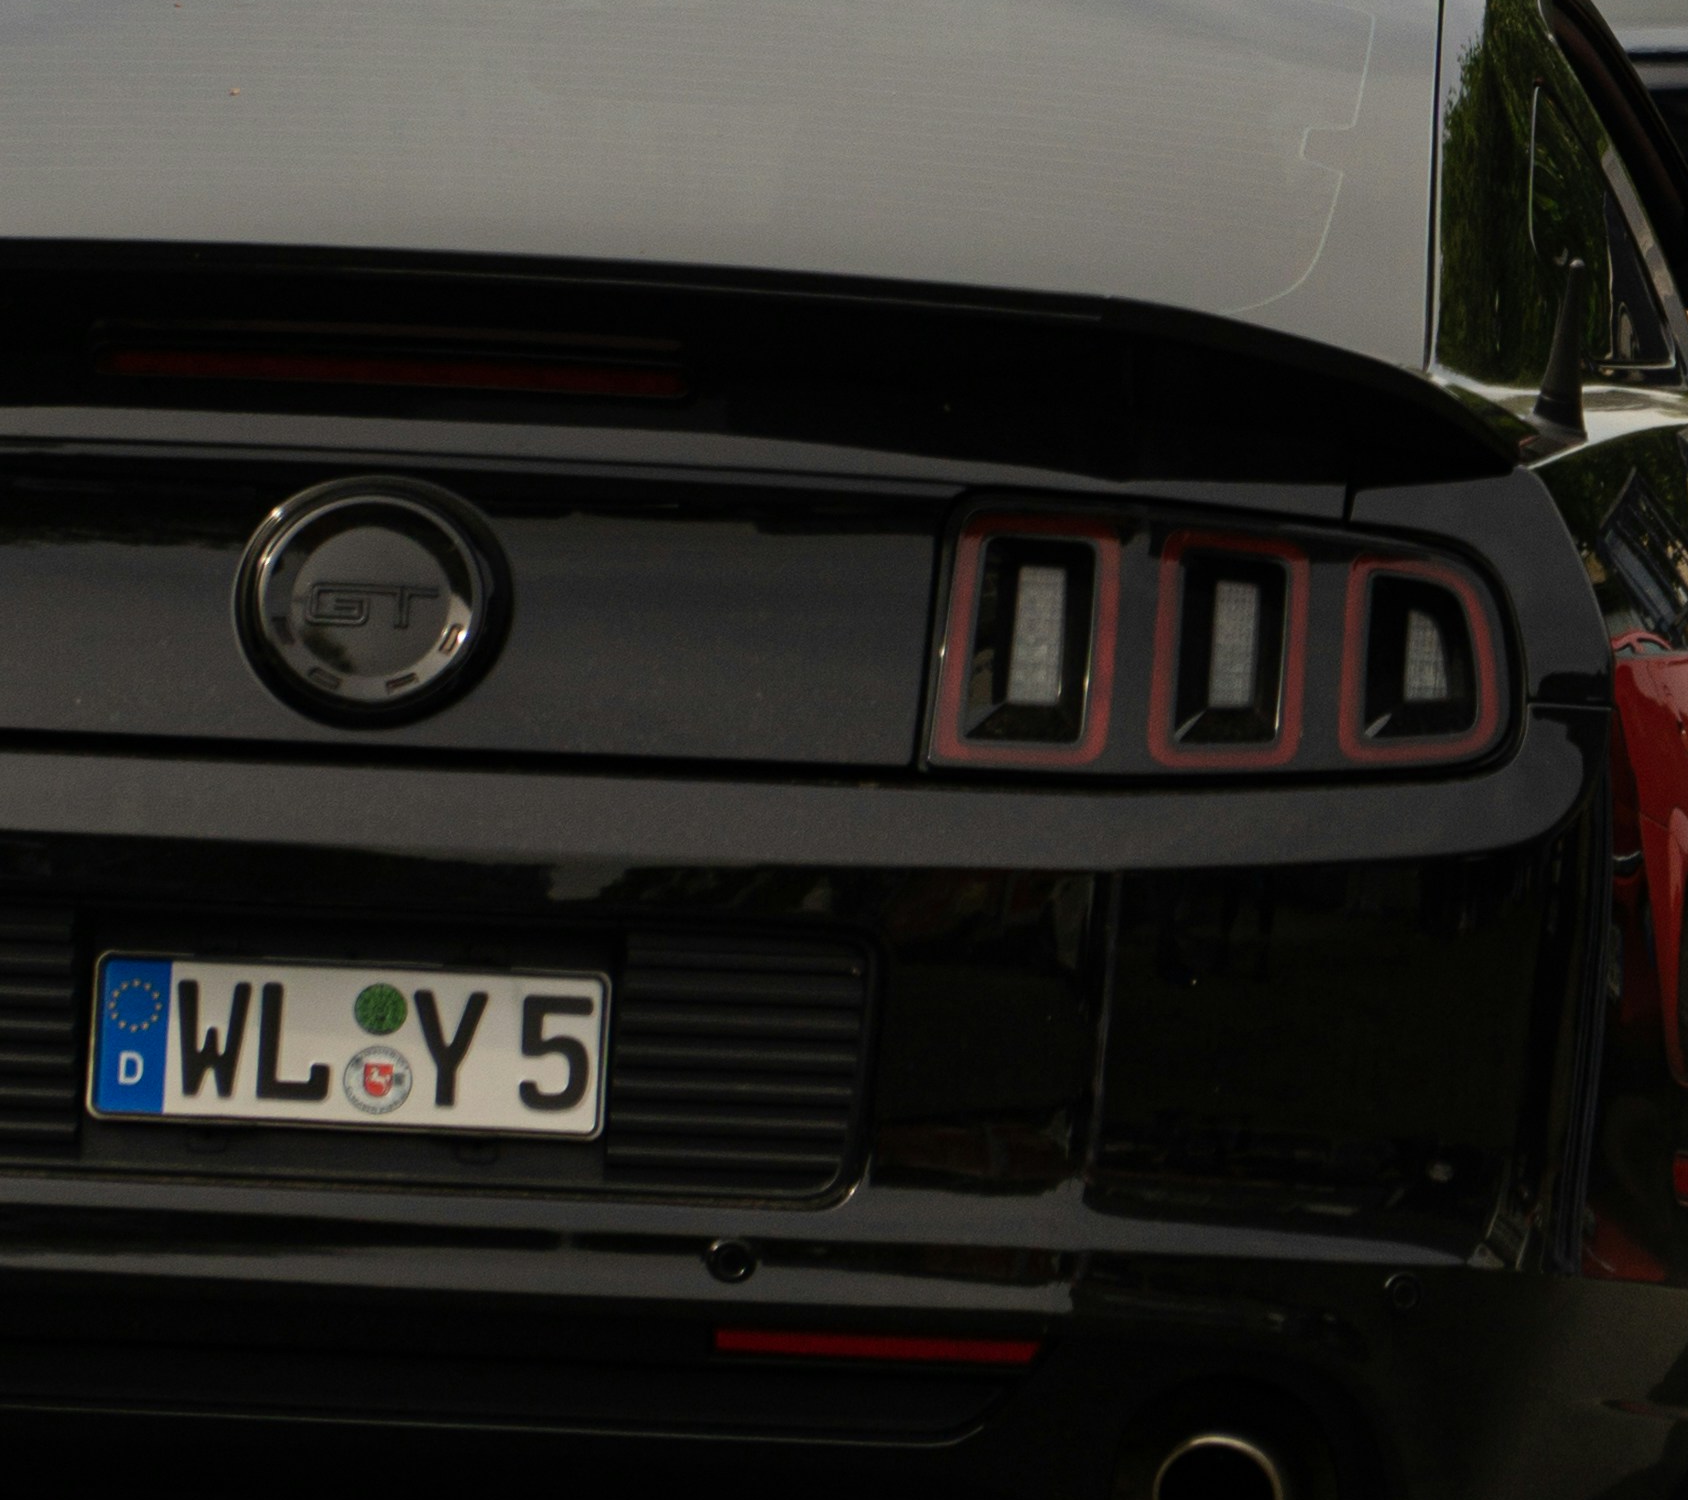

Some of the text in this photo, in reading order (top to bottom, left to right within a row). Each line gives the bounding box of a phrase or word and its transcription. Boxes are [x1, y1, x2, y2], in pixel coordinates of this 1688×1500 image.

[306, 582, 440, 629] GT
[178, 980, 330, 1101] WL
[117, 1051, 144, 1085] D
